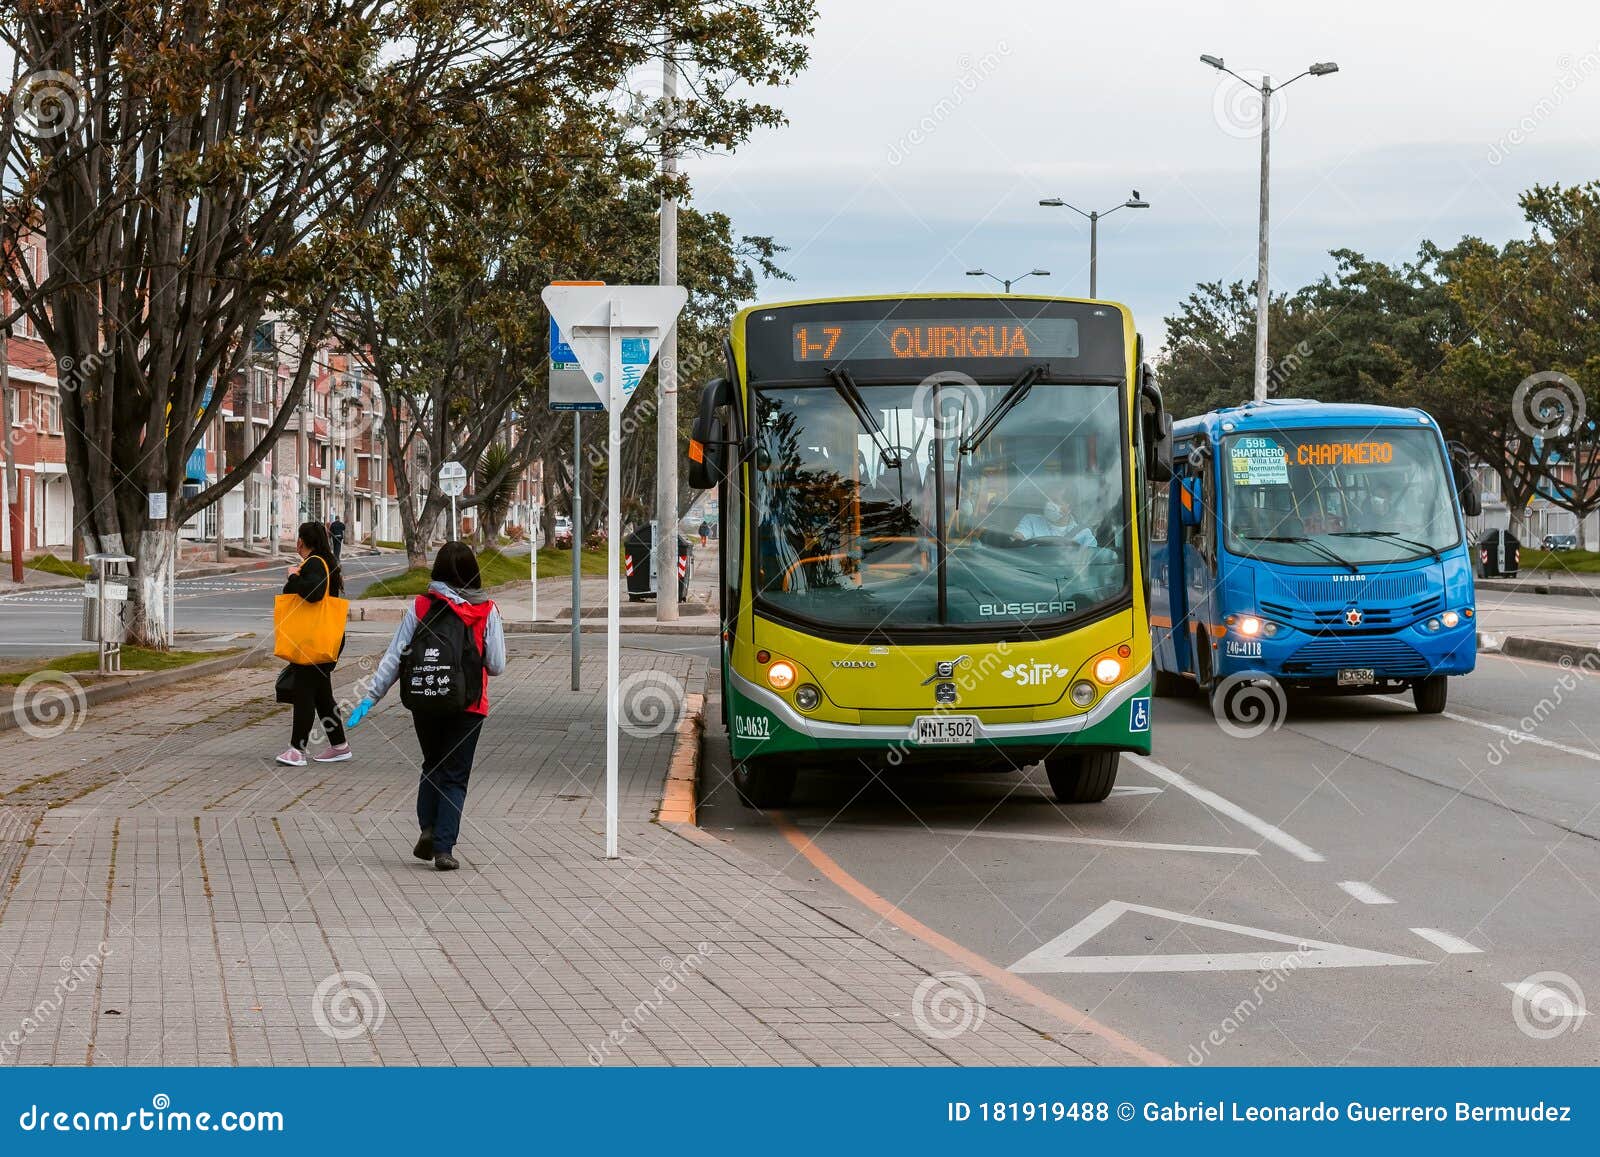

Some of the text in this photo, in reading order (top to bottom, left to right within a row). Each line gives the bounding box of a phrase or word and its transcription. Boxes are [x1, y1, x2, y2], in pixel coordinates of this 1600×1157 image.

[889, 326, 1030, 358] QUIRIGUA
[1246, 439, 1266, 449] 59B
[1231, 448, 1284, 458] CHAPINERO
[979, 601, 1076, 616] BUSSCAR
[832, 660, 877, 668] VOLVO
